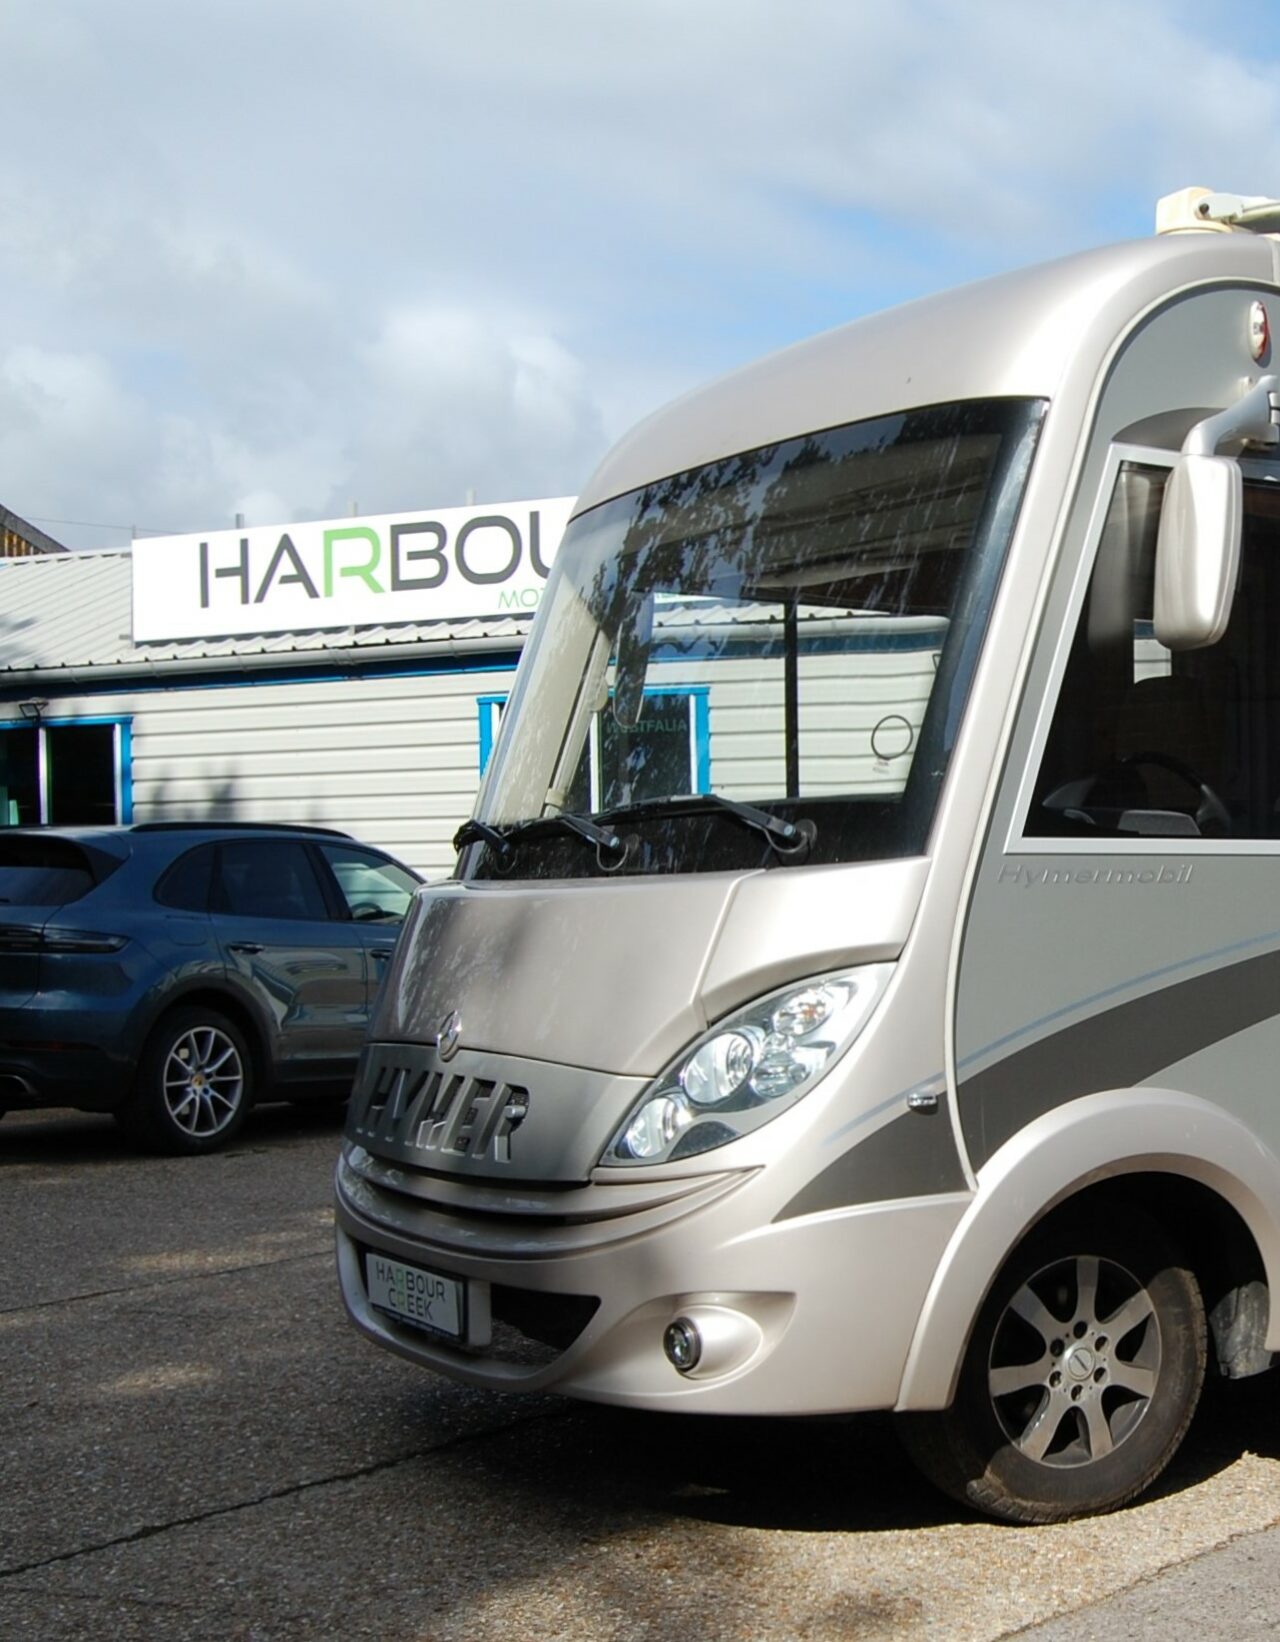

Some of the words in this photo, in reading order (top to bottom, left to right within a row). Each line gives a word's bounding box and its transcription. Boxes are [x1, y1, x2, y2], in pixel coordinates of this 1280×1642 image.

[498, 587, 545, 609] MO
[997, 863, 1194, 889] Hymermobil
[355, 1066, 530, 1165] HYMER
[376, 1261, 446, 1303] HARBOUR
[388, 1287, 433, 1321] CREEK
